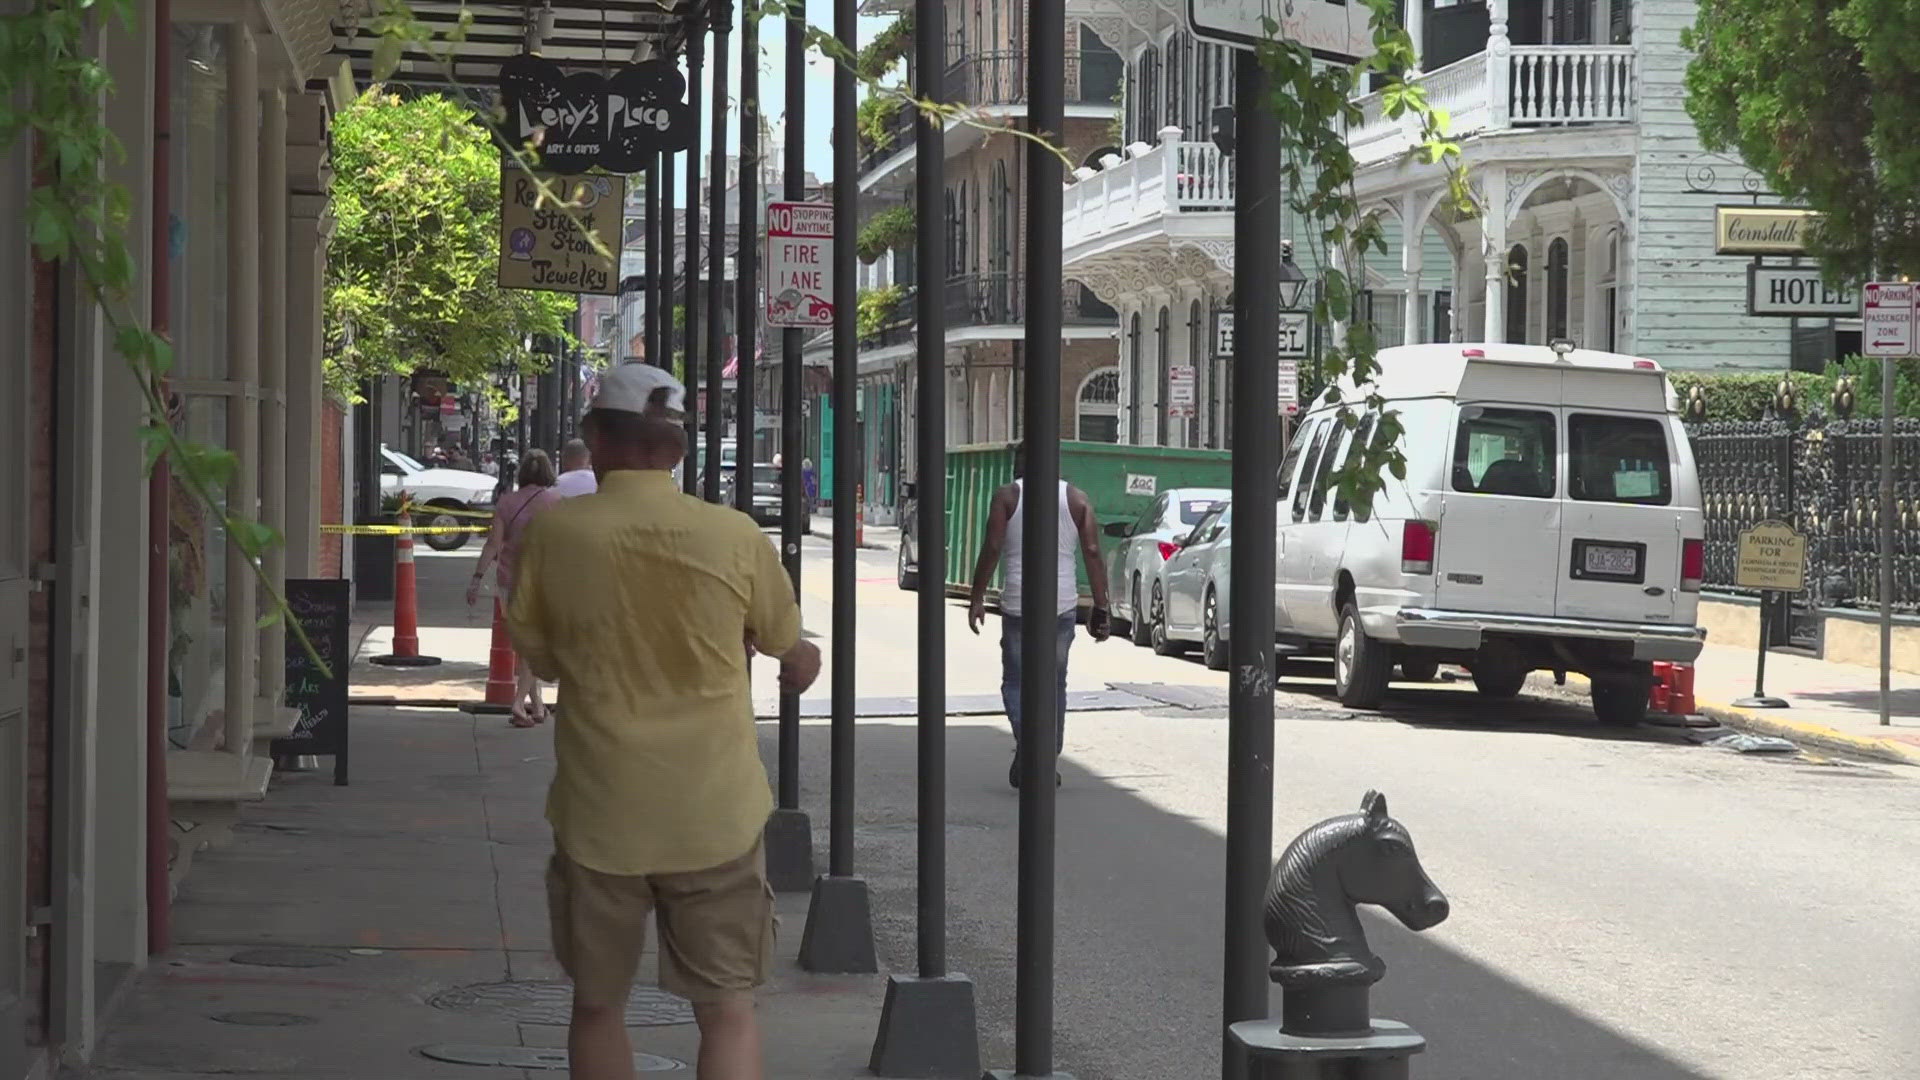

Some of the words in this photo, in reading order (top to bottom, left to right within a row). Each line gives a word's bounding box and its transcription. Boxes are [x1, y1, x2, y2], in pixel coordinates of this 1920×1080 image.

[546, 143, 564, 154] ART
[574, 143, 600, 155] GIFTS
[769, 208, 792, 232] NO
[793, 209, 834, 221] STOPPING
[795, 222, 831, 233] ANYTIME
[1728, 217, 1798, 243] Cornstalk
[784, 245, 819, 264] FIRE
[1866, 289, 1879, 303] NO
[1879, 289, 1912, 301] PARKING
[1867, 314, 1910, 322] PASSENGER
[1877, 327, 1899, 336] ZONE
[1749, 535, 1795, 547] PARKING
[1760, 547, 1781, 557] FOR
